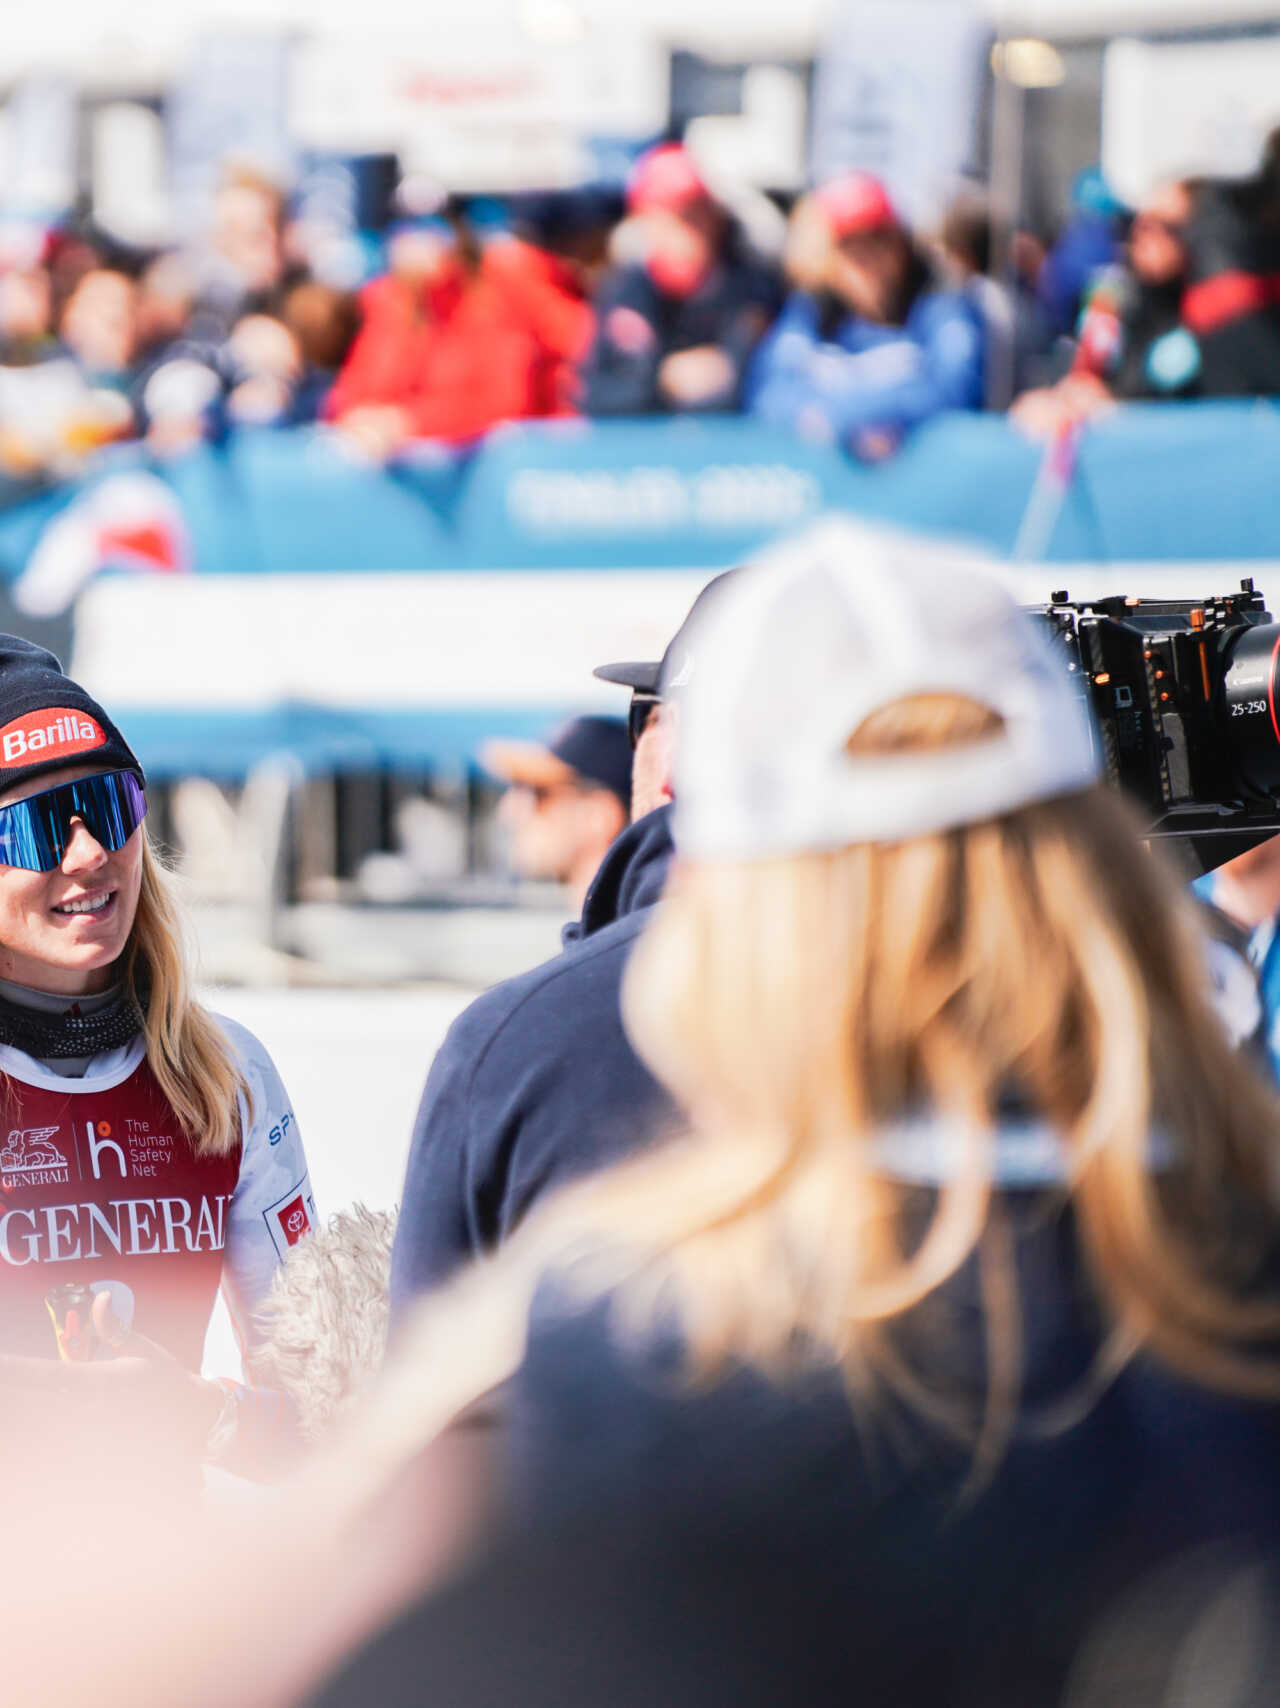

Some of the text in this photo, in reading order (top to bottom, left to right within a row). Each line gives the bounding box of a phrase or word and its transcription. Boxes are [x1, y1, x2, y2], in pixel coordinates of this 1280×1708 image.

[1232, 700, 1266, 716] 25-250
[3, 716, 96, 762] Barilla
[125, 1119, 150, 1132] The
[269, 1110, 294, 1146] SP
[128, 1135, 174, 1148] Human
[130, 1149, 172, 1163] Safety
[133, 1164, 157, 1177] Net
[2, 1169, 69, 1188] GENERALI
